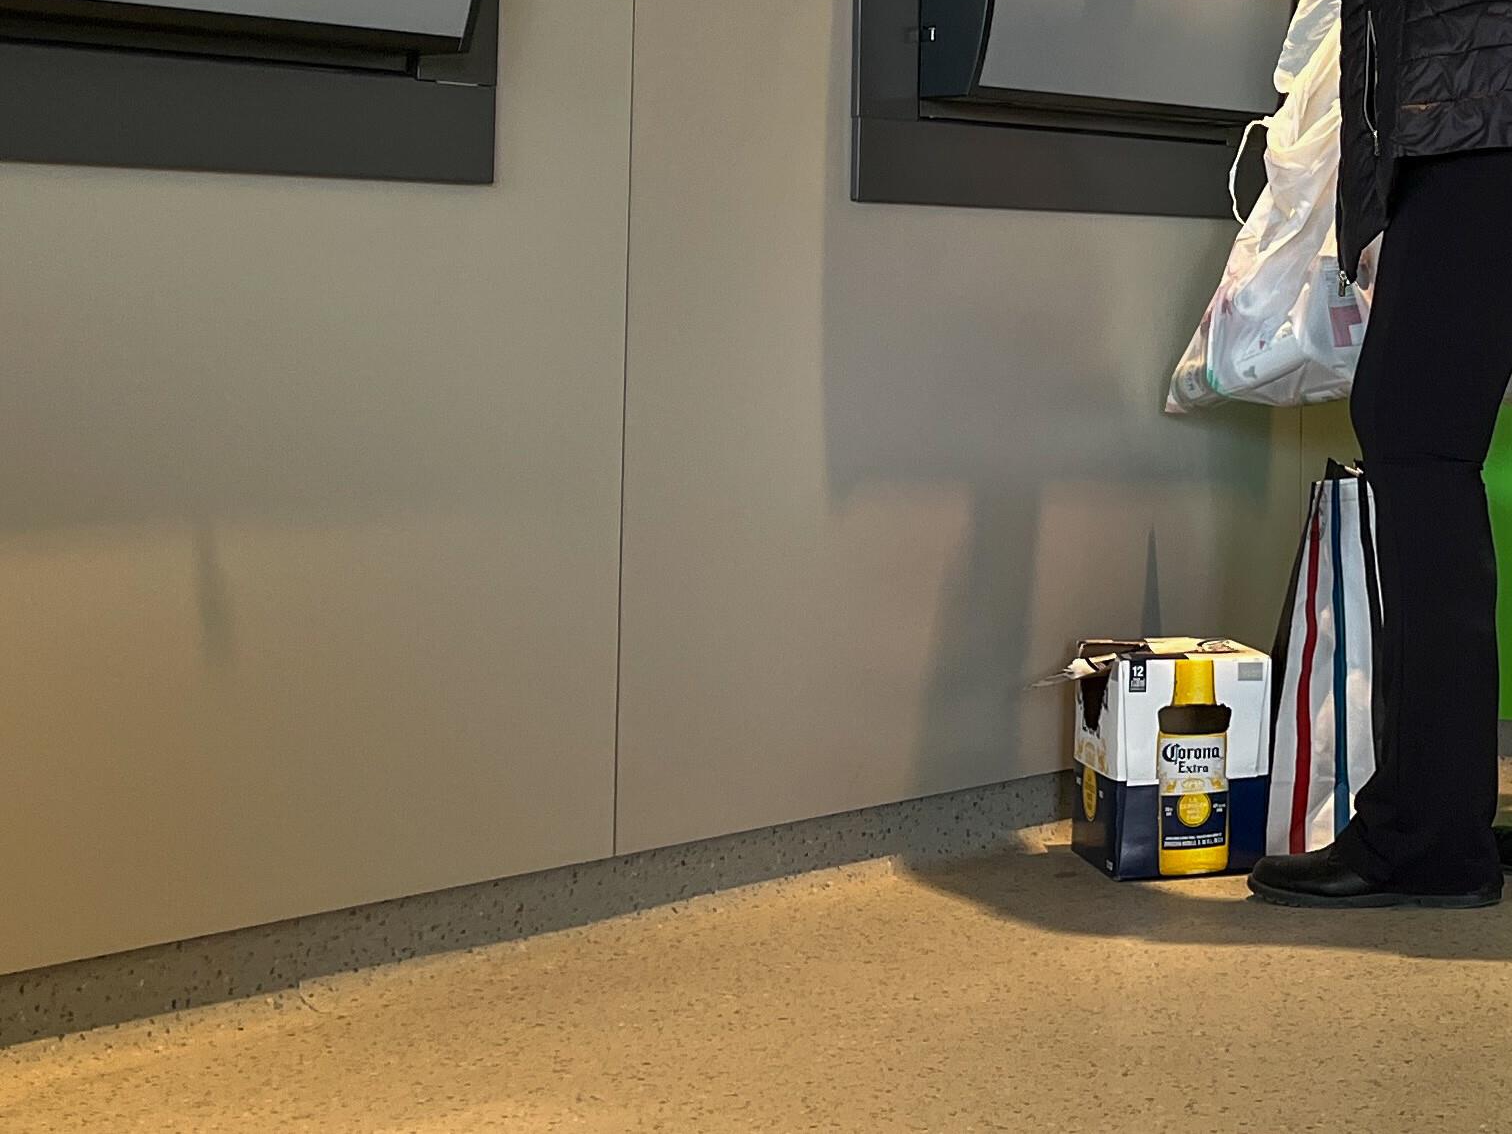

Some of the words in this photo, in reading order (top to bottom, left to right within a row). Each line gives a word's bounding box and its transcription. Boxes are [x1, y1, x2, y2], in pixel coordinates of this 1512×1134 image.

[1132, 665, 1144, 677] 12
[1162, 743, 1220, 765] Corona
[1178, 761, 1209, 773] Extra
